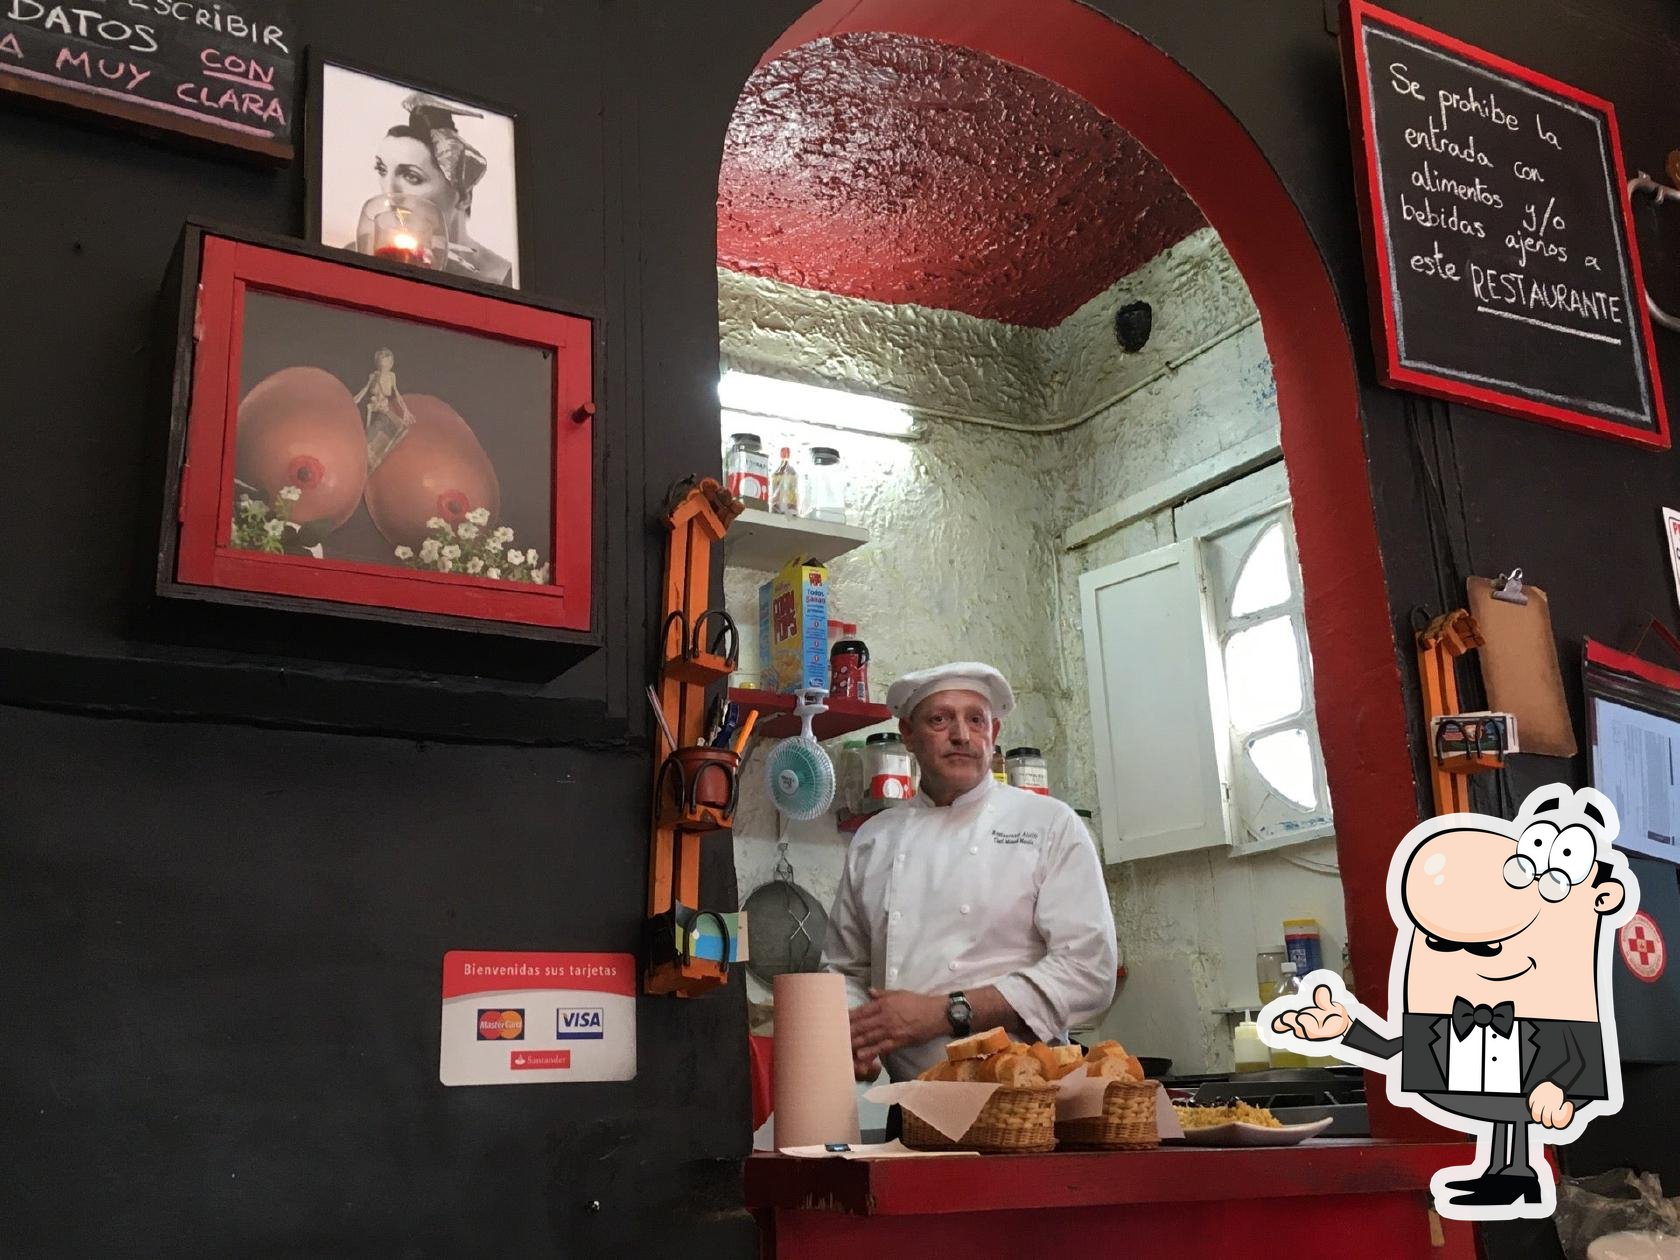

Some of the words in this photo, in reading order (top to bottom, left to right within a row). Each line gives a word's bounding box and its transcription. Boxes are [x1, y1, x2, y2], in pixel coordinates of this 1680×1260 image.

[8, 0, 158, 52] DATOS
[200, 48, 274, 83] CON
[56, 48, 151, 90] MUY
[177, 83, 286, 126] CLARA
[1389, 63, 1426, 101] Se
[1439, 87, 1519, 131] prohibe
[1536, 113, 1562, 150] la
[1404, 115, 1494, 168] entrada
[1513, 161, 1545, 183] con
[1400, 194, 1486, 238] bebidas
[1505, 230, 1568, 268] ajenos
[1584, 255, 1601, 271] a
[1411, 160, 1504, 209] alimentos
[1522, 197, 1566, 236] y/o
[1410, 241, 1461, 281] este
[1470, 263, 1622, 324] RESTAURANTE
[464, 963, 540, 977] Bienvenidas
[544, 965, 565, 977] sus
[569, 964, 617, 979] tarjetas
[479, 1020, 522, 1031] MasterCard
[562, 1012, 601, 1028] VISA
[527, 1055, 566, 1065] Santander
